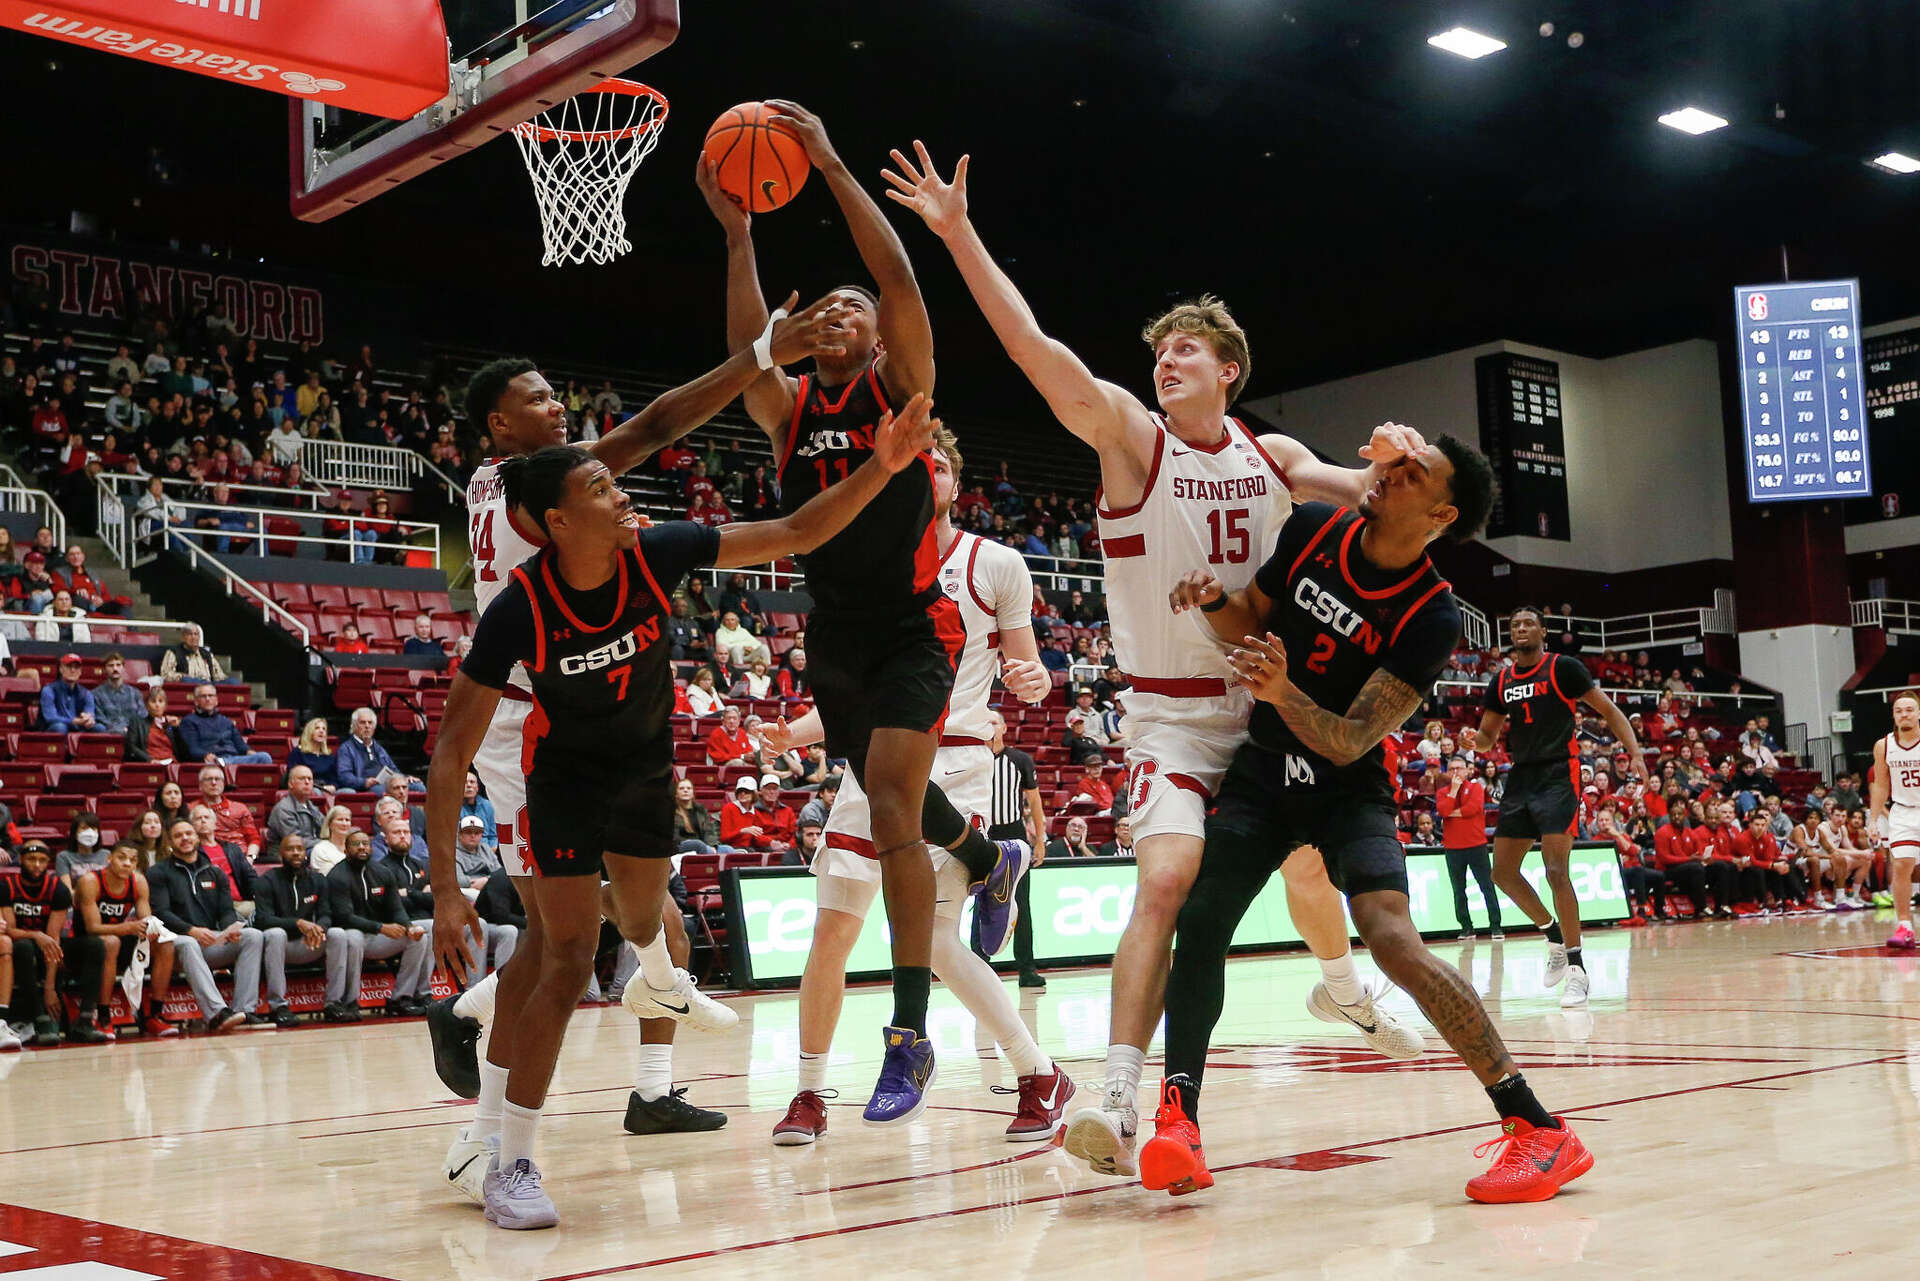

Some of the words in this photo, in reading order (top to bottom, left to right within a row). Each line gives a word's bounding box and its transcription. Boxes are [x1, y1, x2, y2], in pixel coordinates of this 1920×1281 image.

[12, 245, 323, 346] STANFORD
[1750, 330, 1770, 344] 13
[1788, 329, 1810, 340] PTS
[1828, 325, 1849, 339] 13
[1788, 349, 1812, 360] REB
[1758, 371, 1767, 384] 2
[1791, 370, 1814, 381] AST
[1836, 367, 1846, 379] 4
[1870, 361, 1890, 373] 1942
[1760, 392, 1769, 404] 3
[1792, 390, 1814, 402] STL
[1840, 388, 1847, 400] 1
[1866, 390, 1920, 408] ARANCE
[1761, 413, 1770, 426] 2
[1798, 411, 1814, 422] TO
[1840, 408, 1849, 420] 3
[1754, 433, 1780, 446] 33.3
[1833, 429, 1859, 442] 50.0
[813, 457, 849, 493] 11
[1174, 475, 1267, 501] STANFORD
[1207, 508, 1250, 565] 15
[1295, 577, 1382, 655] CSUN
[559, 614, 660, 676] CSUN
[1306, 633, 1337, 675] 2
[607, 664, 633, 701] 7
[1504, 681, 1548, 703] CSUN
[1522, 702, 1534, 724] 1
[1900, 769, 1920, 788] 25
[14, 903, 51, 916] CSUN
